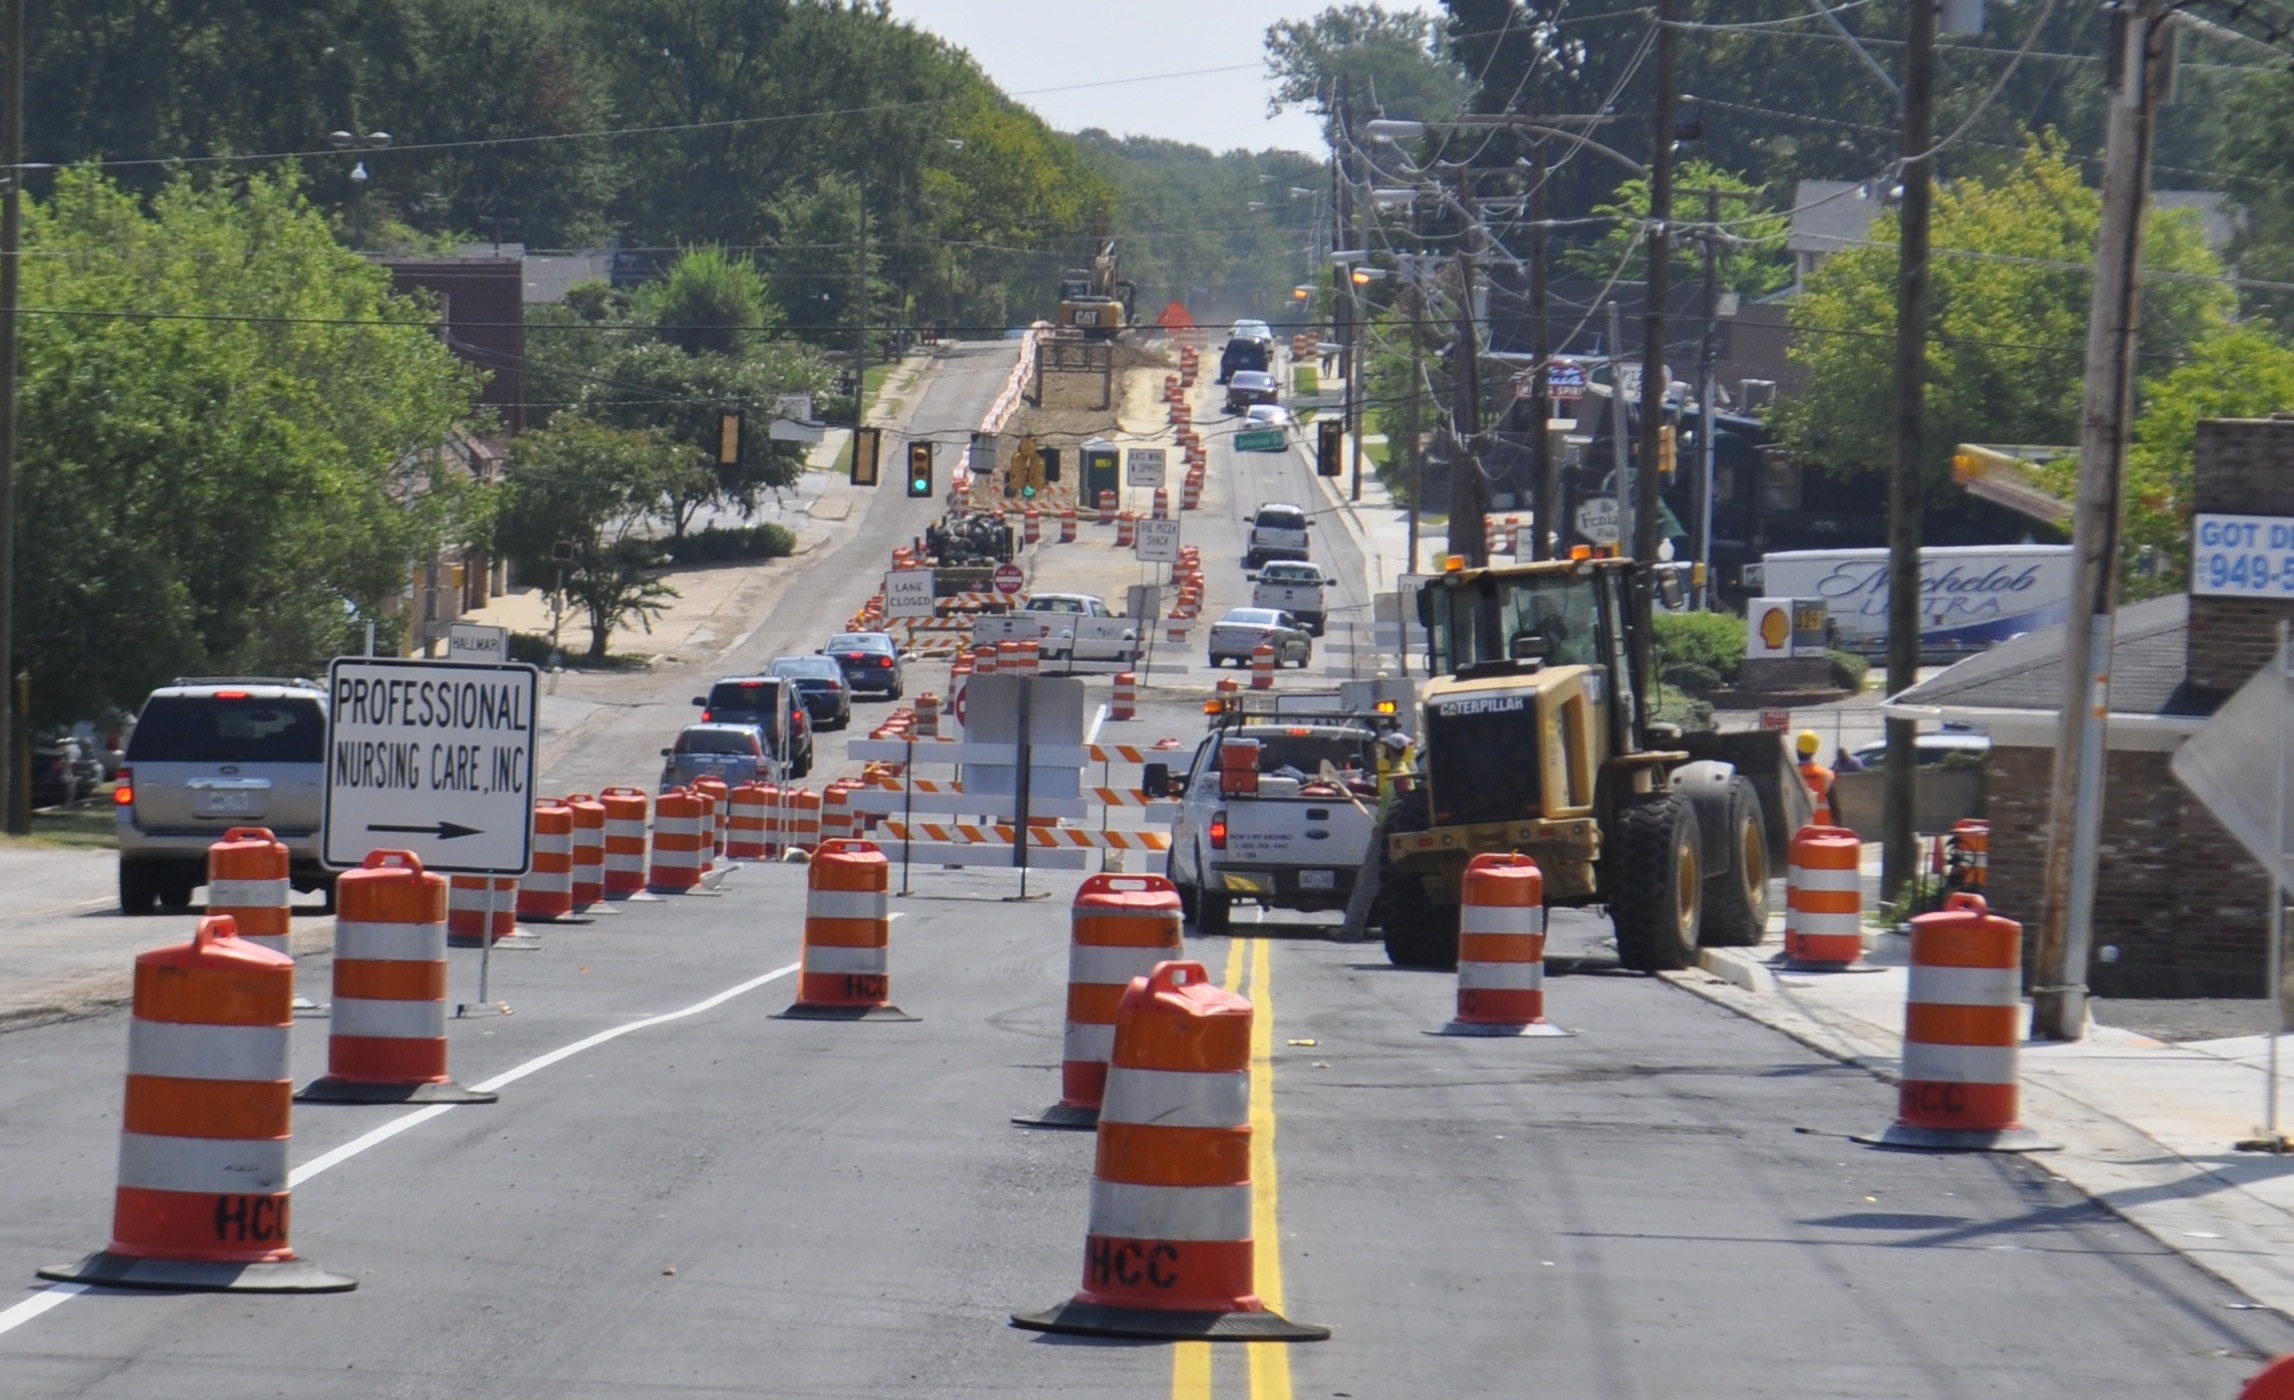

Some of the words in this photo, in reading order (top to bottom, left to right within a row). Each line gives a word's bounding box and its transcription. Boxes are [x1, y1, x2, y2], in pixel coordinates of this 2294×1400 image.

[1075, 310, 1098, 325] CAT
[1157, 523, 1177, 535] PIZZA
[2201, 521, 2261, 548] GOT
[1146, 535, 1168, 546] SHACK
[895, 581, 923, 593] LANE
[1817, 560, 2042, 597] Mchelob
[890, 596, 931, 607] CLOSED
[1861, 597, 2001, 616] UTRA
[453, 637, 499, 652] HALLMAR
[337, 677, 527, 731] PROFESSIONAL
[1440, 698, 1524, 716] CATERPILLAR
[336, 740, 420, 790] NURSING
[1090, 1238, 1179, 1289] HCC
